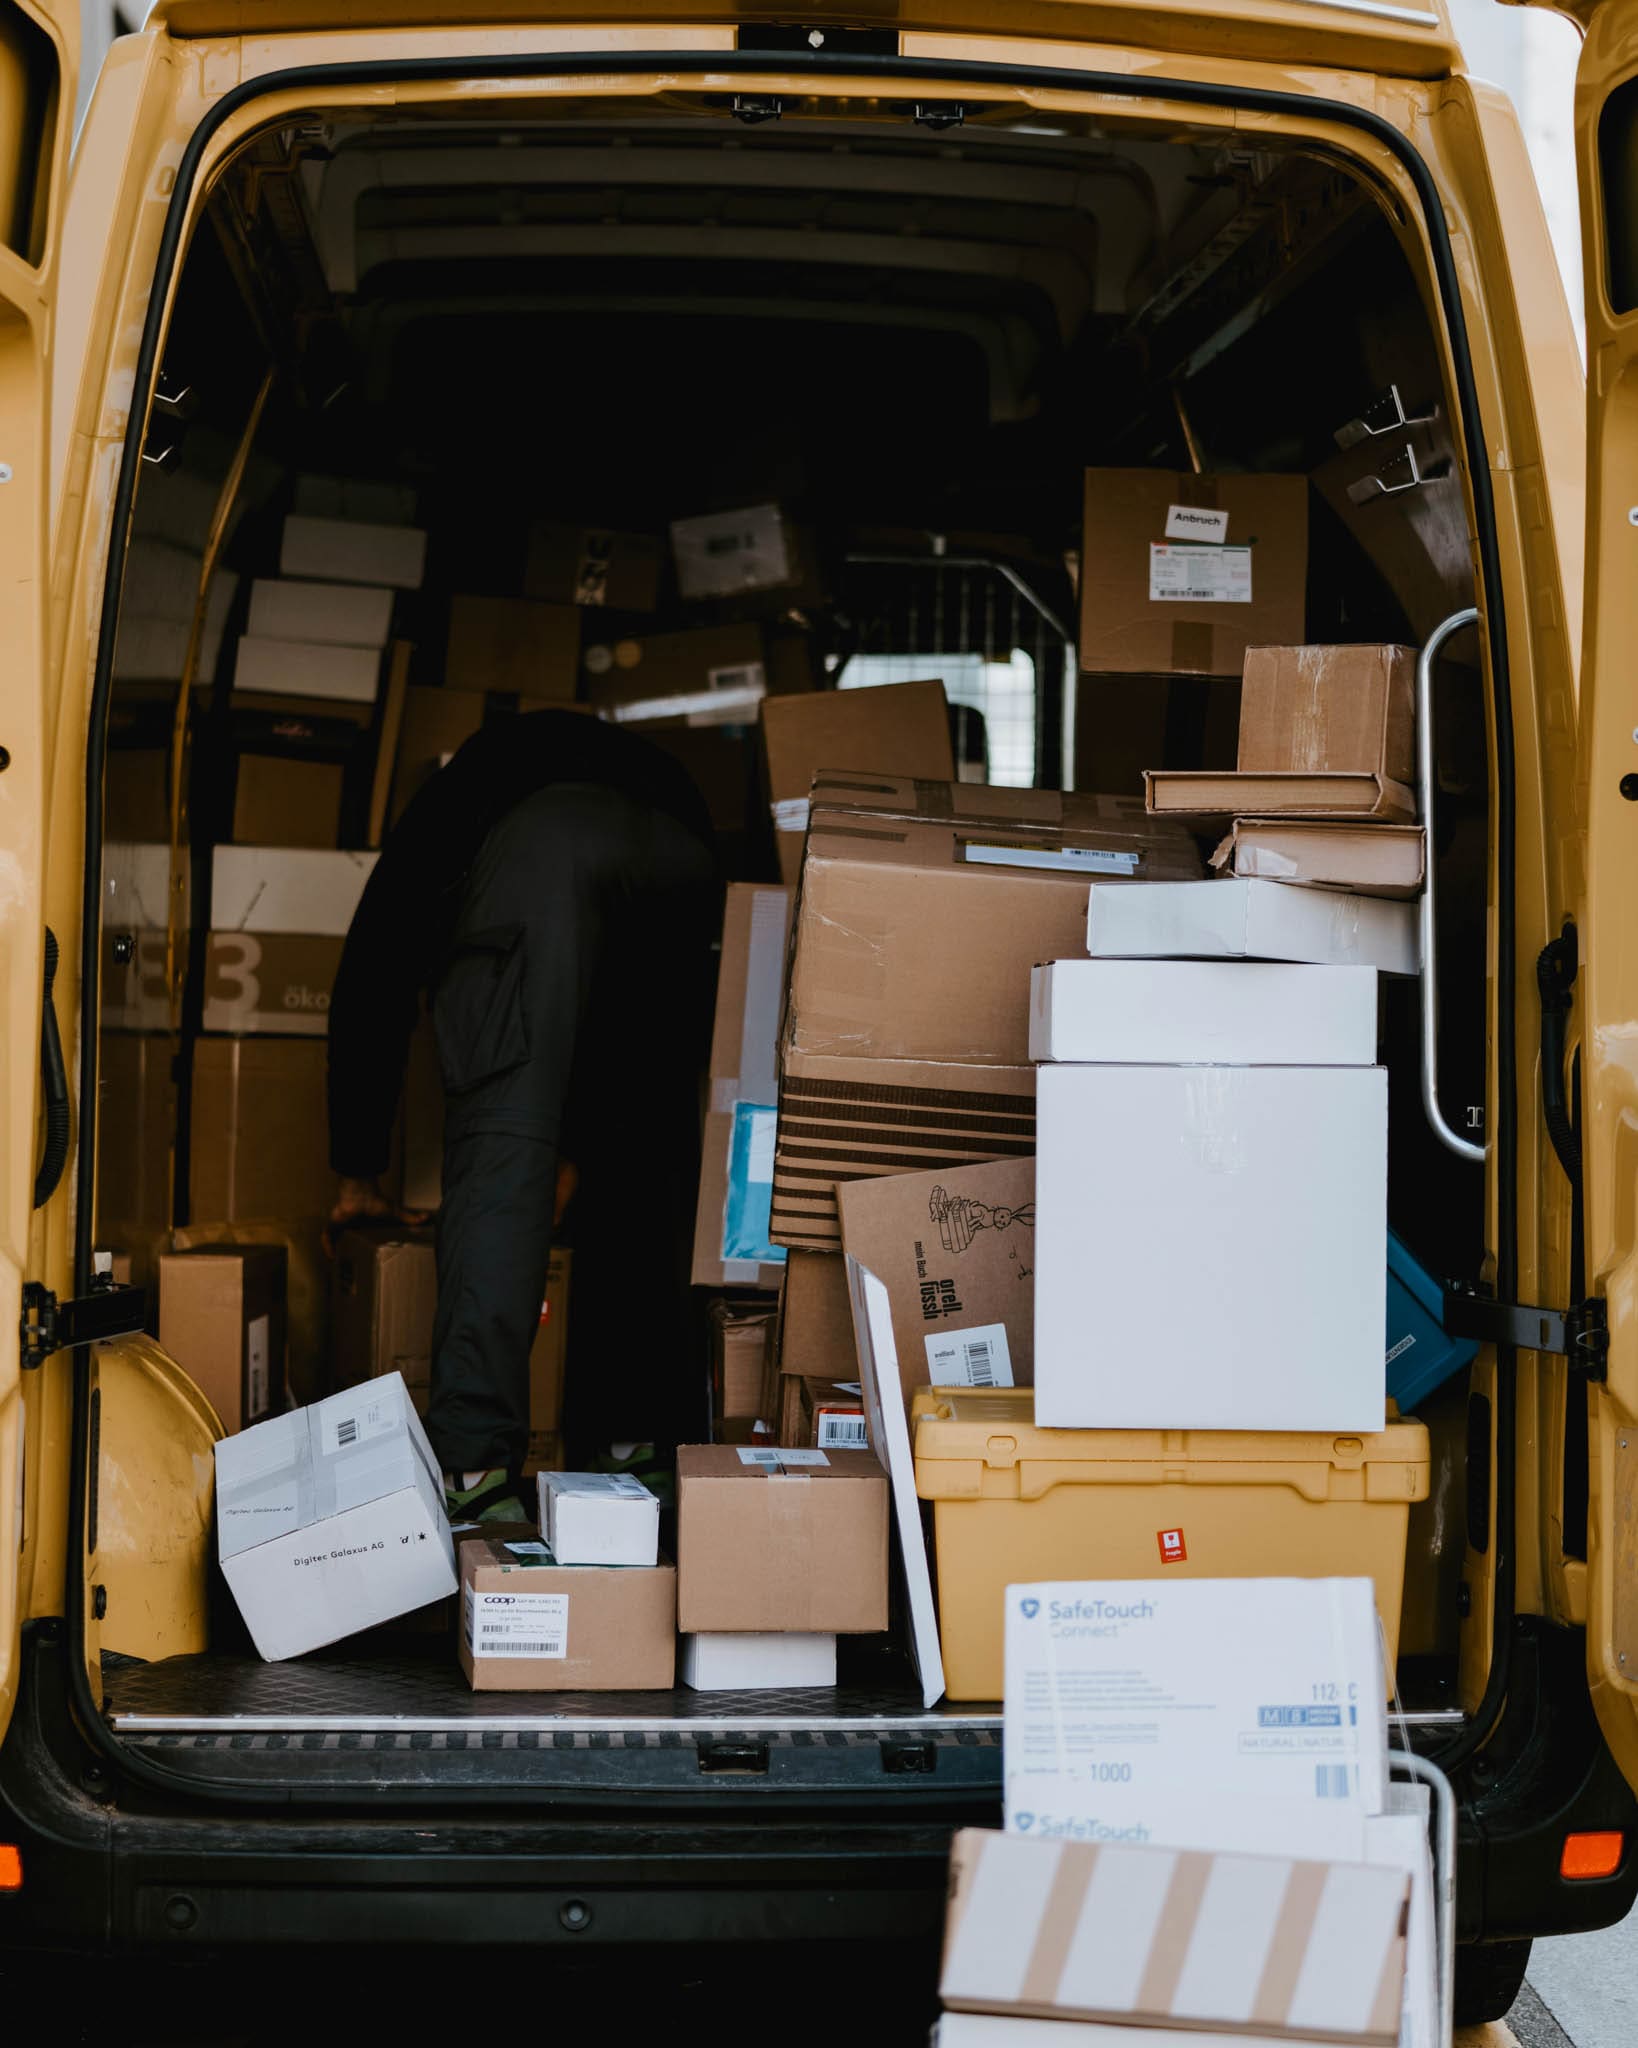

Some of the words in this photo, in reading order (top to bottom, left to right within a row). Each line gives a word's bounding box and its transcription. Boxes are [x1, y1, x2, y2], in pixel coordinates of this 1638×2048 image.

[1175, 513, 1221, 525] Anbruch
[917, 1260, 928, 1278] Buch
[294, 1553, 328, 1566] Digitec
[330, 1545, 368, 1559] Galaxus
[371, 1541, 385, 1550] AG
[484, 1597, 516, 1606] coop
[1050, 1599, 1153, 1619] SafeTouch
[1051, 1622, 1118, 1638] Connect
[1091, 1762, 1132, 1783] 1000
[1040, 1814, 1150, 1841] SafeTouch
